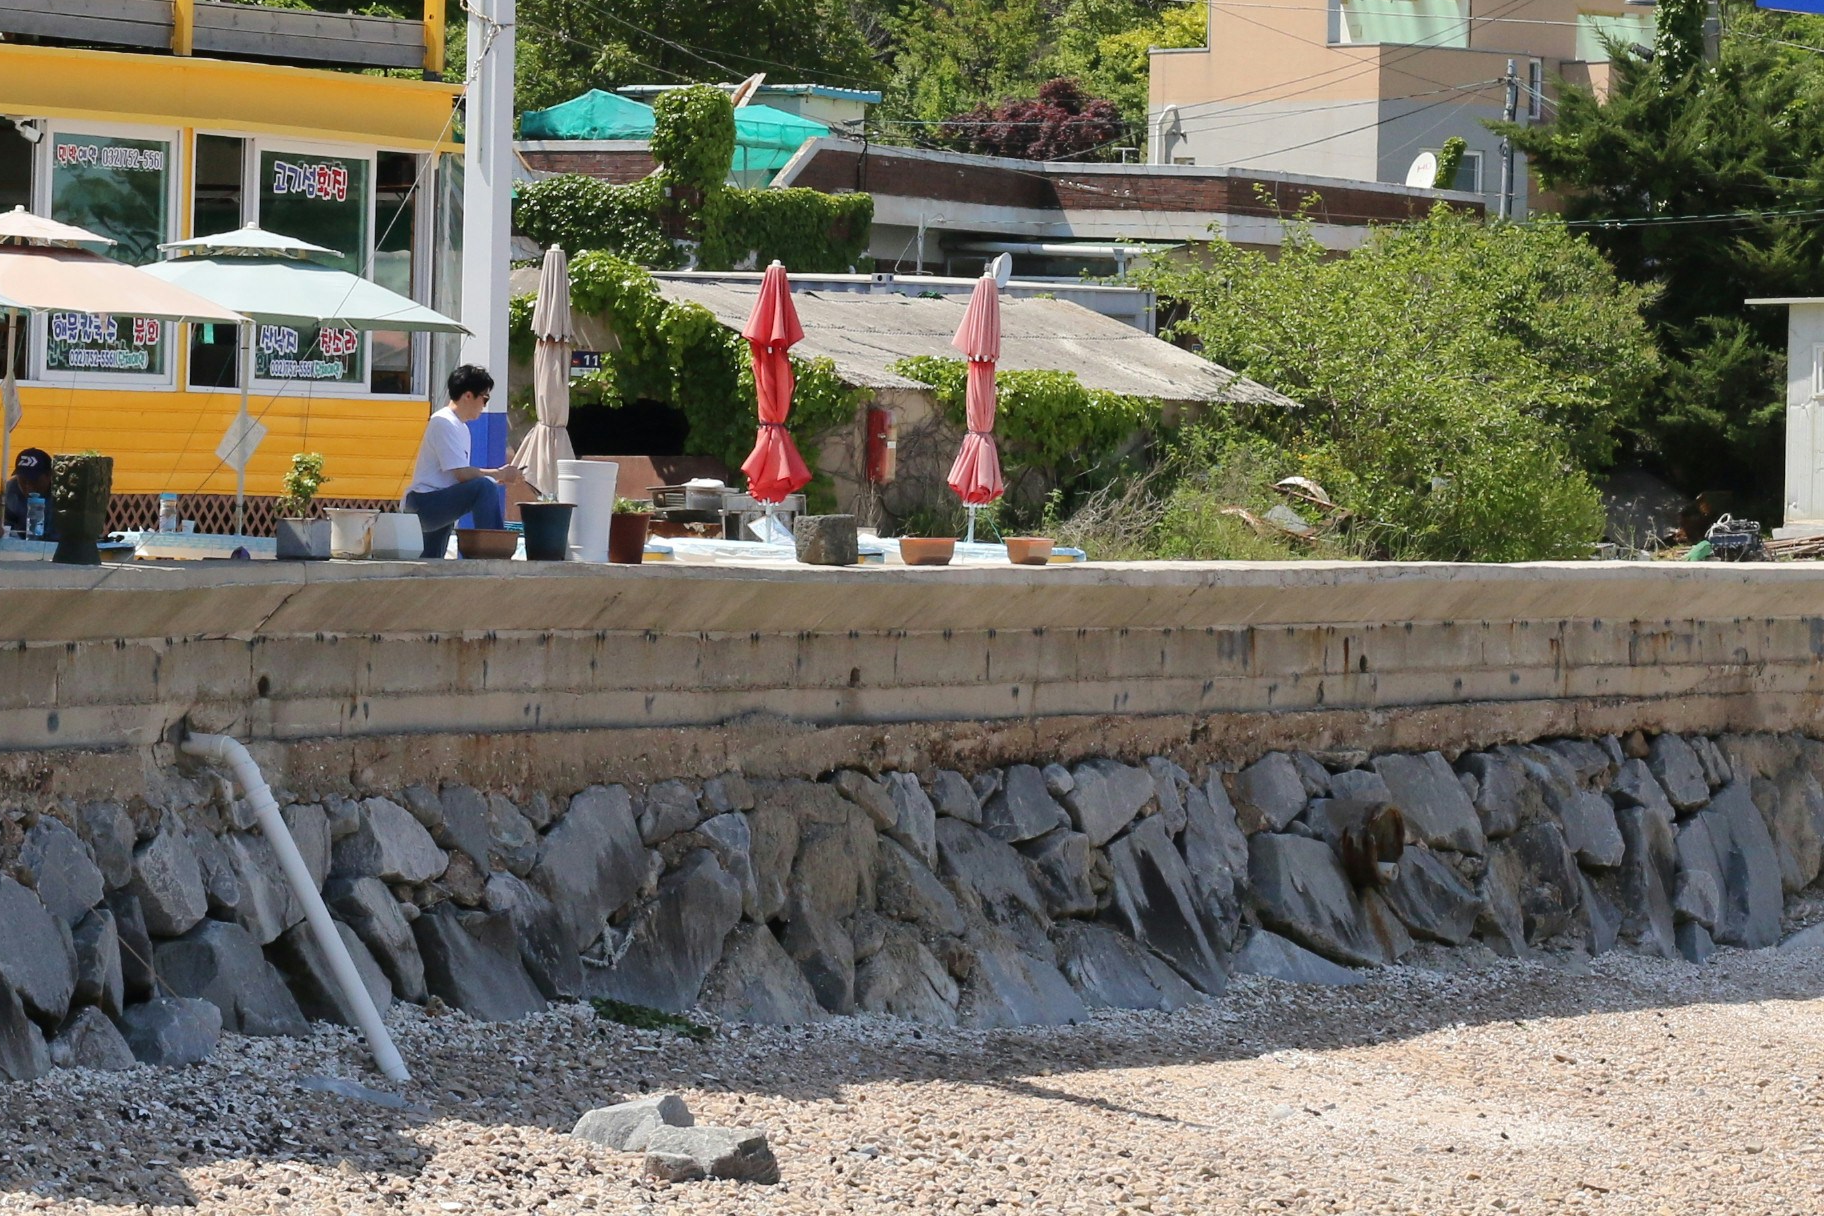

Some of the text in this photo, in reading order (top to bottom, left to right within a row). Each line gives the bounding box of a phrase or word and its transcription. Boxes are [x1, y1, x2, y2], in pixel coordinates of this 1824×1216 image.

[273, 160, 348, 202] 고기섬횟집
[259, 325, 298, 356] 산낙지
[583, 354, 598, 366] 11
